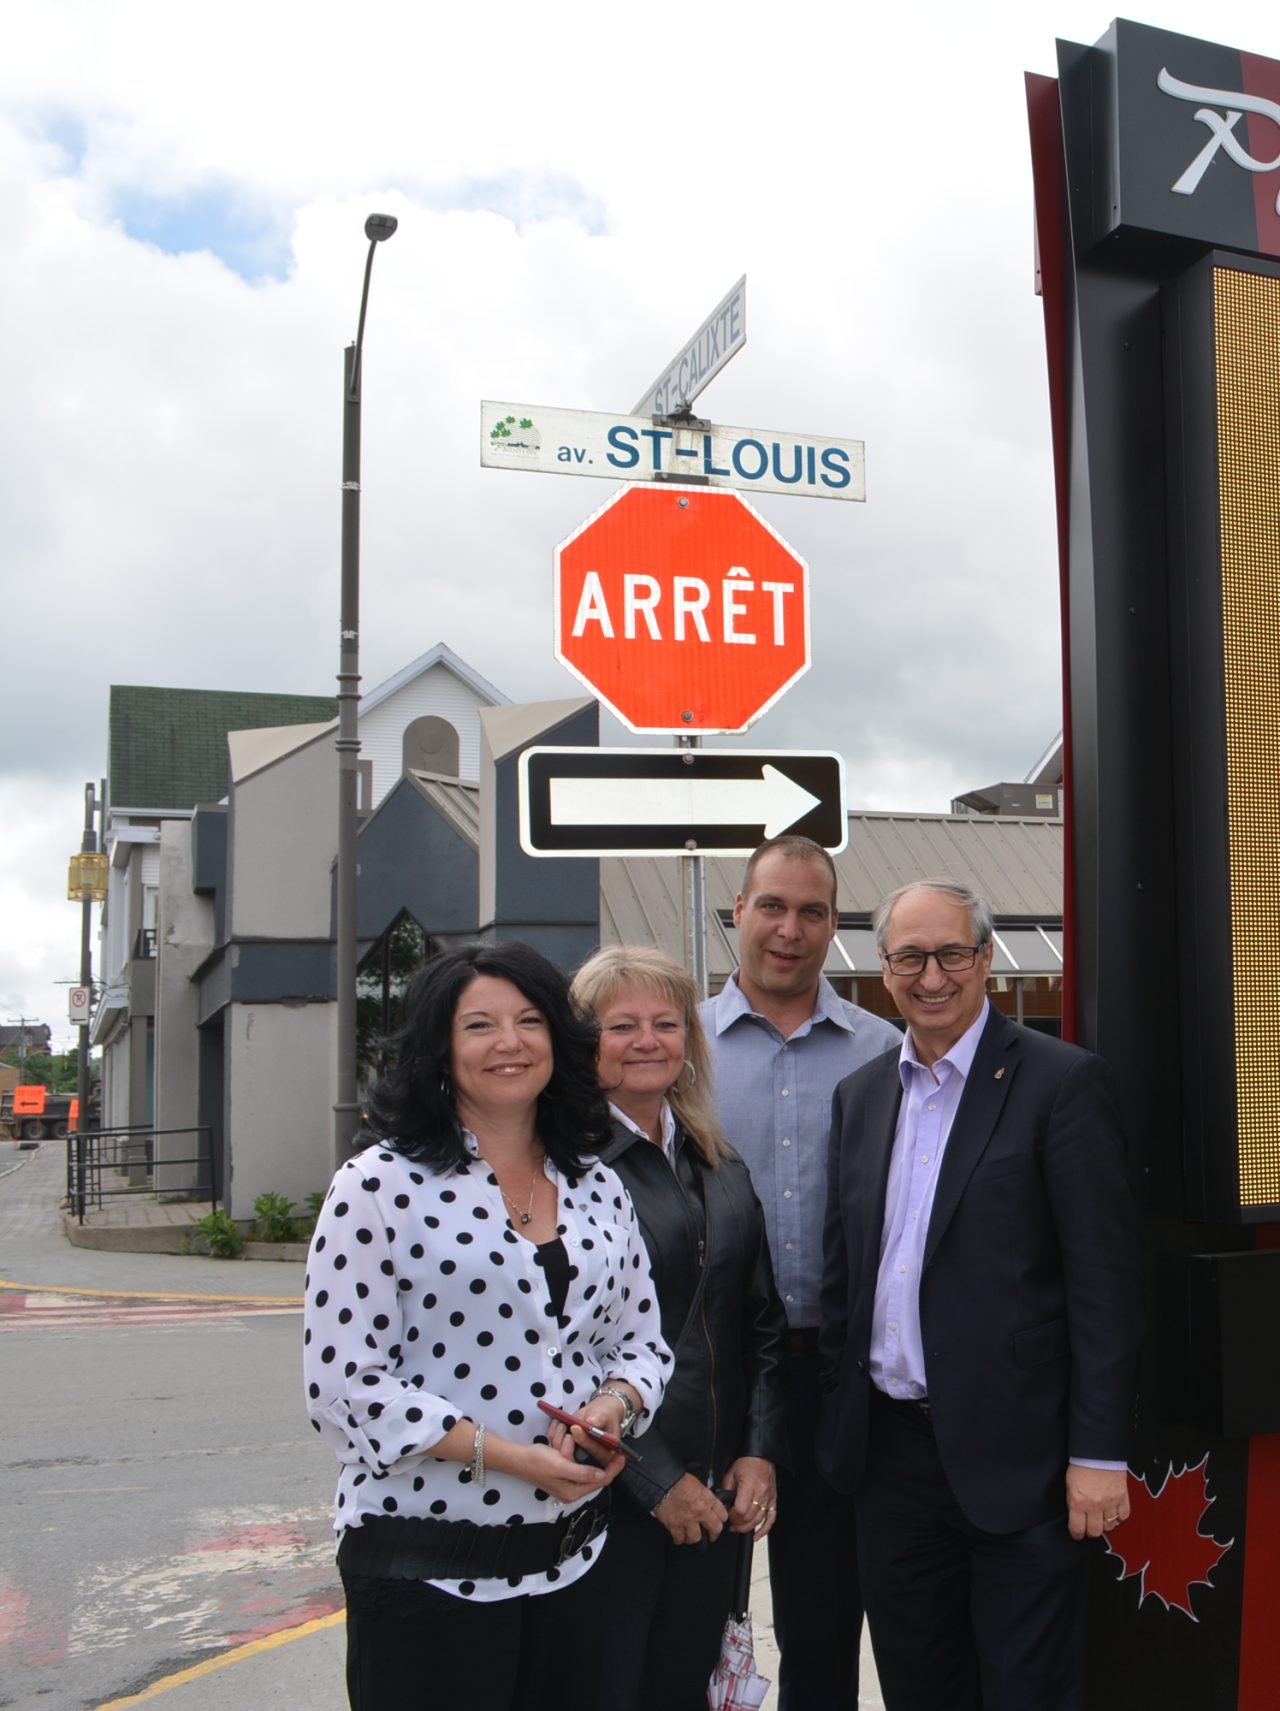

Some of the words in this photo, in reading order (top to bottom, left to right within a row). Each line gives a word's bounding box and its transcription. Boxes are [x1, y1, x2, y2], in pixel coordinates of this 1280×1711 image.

[655, 293, 742, 415] ST-CALIXTE
[557, 444, 594, 464] av.
[606, 425, 851, 488] ST-LOUIS
[572, 566, 795, 646] ARRÊT
